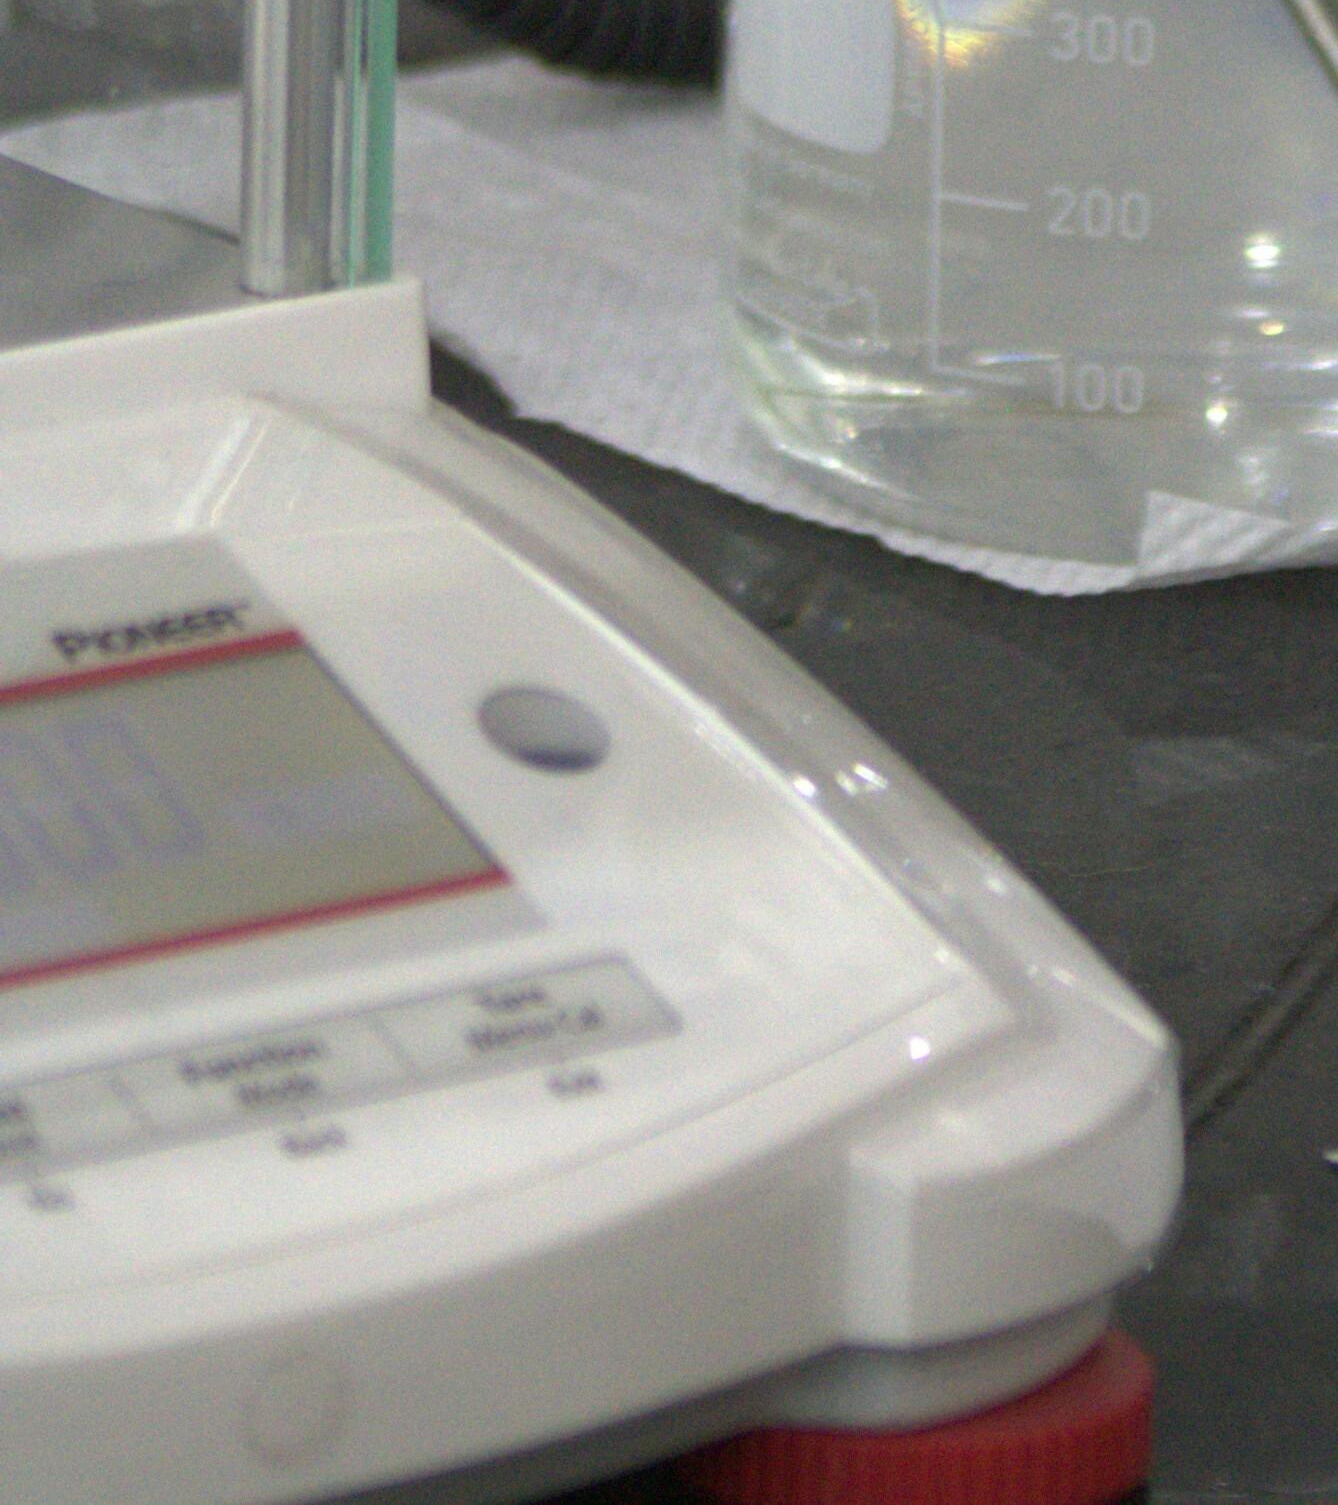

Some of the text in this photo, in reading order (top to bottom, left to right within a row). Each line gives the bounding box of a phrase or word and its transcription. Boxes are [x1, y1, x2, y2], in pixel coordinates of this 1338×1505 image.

[1049, 14, 1156, 68] 300
[1046, 187, 1152, 241] 200
[1047, 363, 1146, 415] 100
